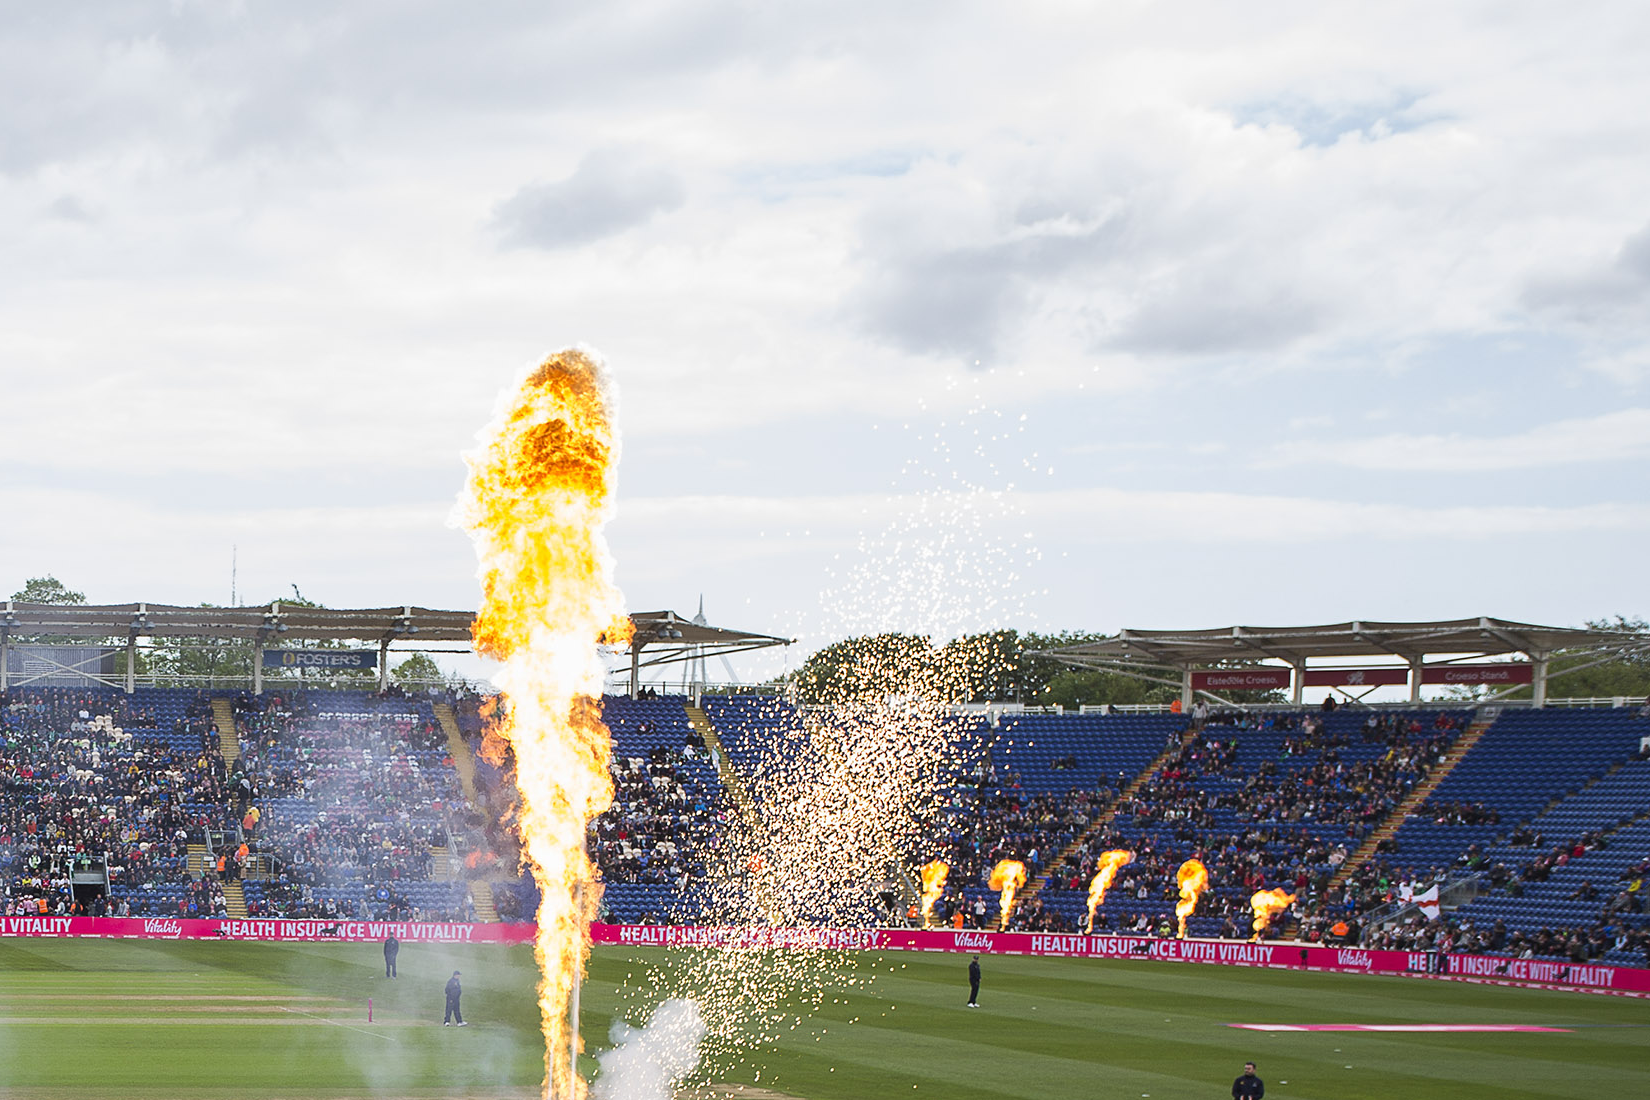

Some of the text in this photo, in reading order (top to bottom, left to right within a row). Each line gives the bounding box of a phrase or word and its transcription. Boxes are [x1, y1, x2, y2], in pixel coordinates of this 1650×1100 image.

[296, 652, 361, 666] FOSTER'S
[9, 917, 72, 934] VITALITY
[144, 918, 182, 937] Vitality
[219, 920, 277, 938] HEALTH
[367, 922, 408, 938] WITH
[410, 923, 474, 940] VITALITY
[620, 926, 676, 944] HEALTH
[953, 932, 994, 951] Vitality
[1031, 935, 1088, 954] HEALTH
[1179, 942, 1217, 960] WITH
[1218, 943, 1274, 963] VITALITY
[1337, 949, 1373, 970] Vitality
[1529, 962, 1555, 981] WITH
